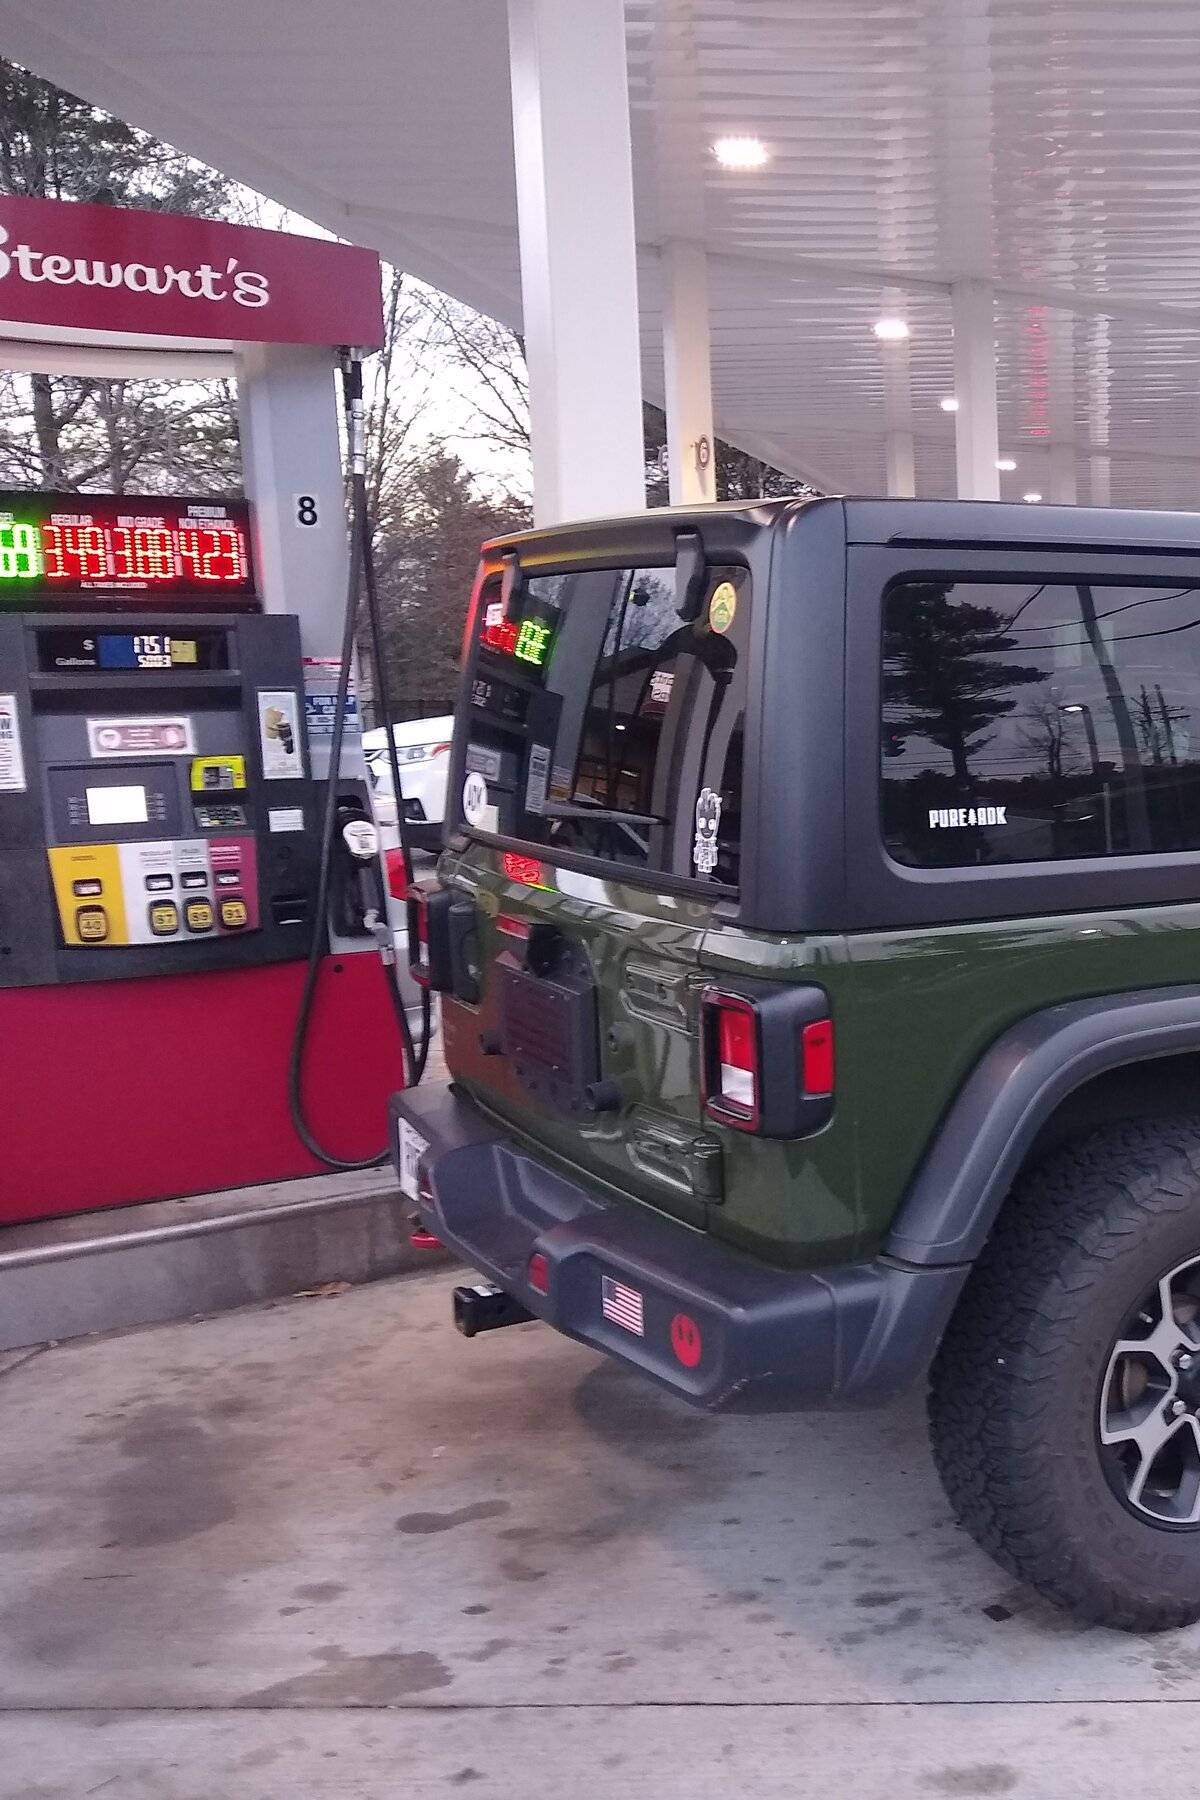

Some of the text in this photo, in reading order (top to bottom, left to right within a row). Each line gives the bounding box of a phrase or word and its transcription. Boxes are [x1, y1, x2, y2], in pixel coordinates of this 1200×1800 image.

[0, 224, 270, 308] tewart's
[51, 514, 93, 526] REGULAR
[298, 496, 318, 526] 8
[55, 657, 96, 667] Gallons
[928, 808, 968, 829] PURE
